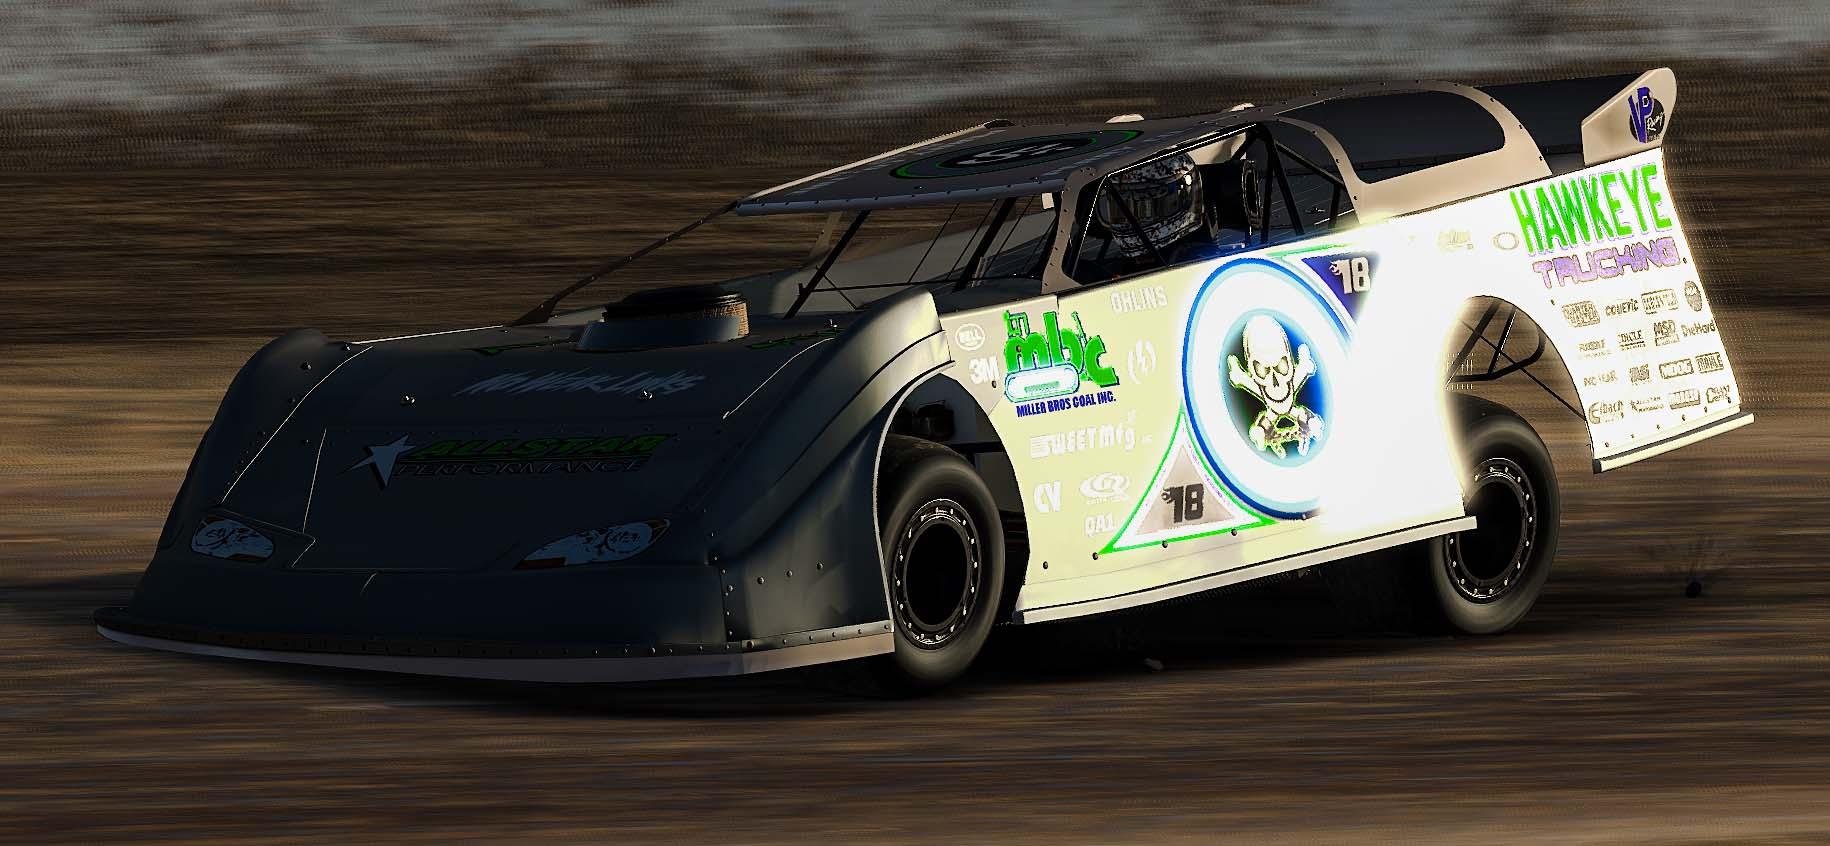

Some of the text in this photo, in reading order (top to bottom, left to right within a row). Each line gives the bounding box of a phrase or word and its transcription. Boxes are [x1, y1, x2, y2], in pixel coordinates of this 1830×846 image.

[1627, 86, 1656, 143] VP
[1509, 164, 1673, 255] HAWKEYE
[1331, 256, 1371, 294] 18
[1532, 236, 1680, 290] TRUCKING
[968, 355, 1000, 385] 3M
[1016, 401, 1047, 418] MILLER
[1072, 393, 1096, 409] COAL
[411, 434, 674, 459] ALLSTAR
[394, 460, 642, 477] PERFORMANCE
[1161, 482, 1205, 524] 18
